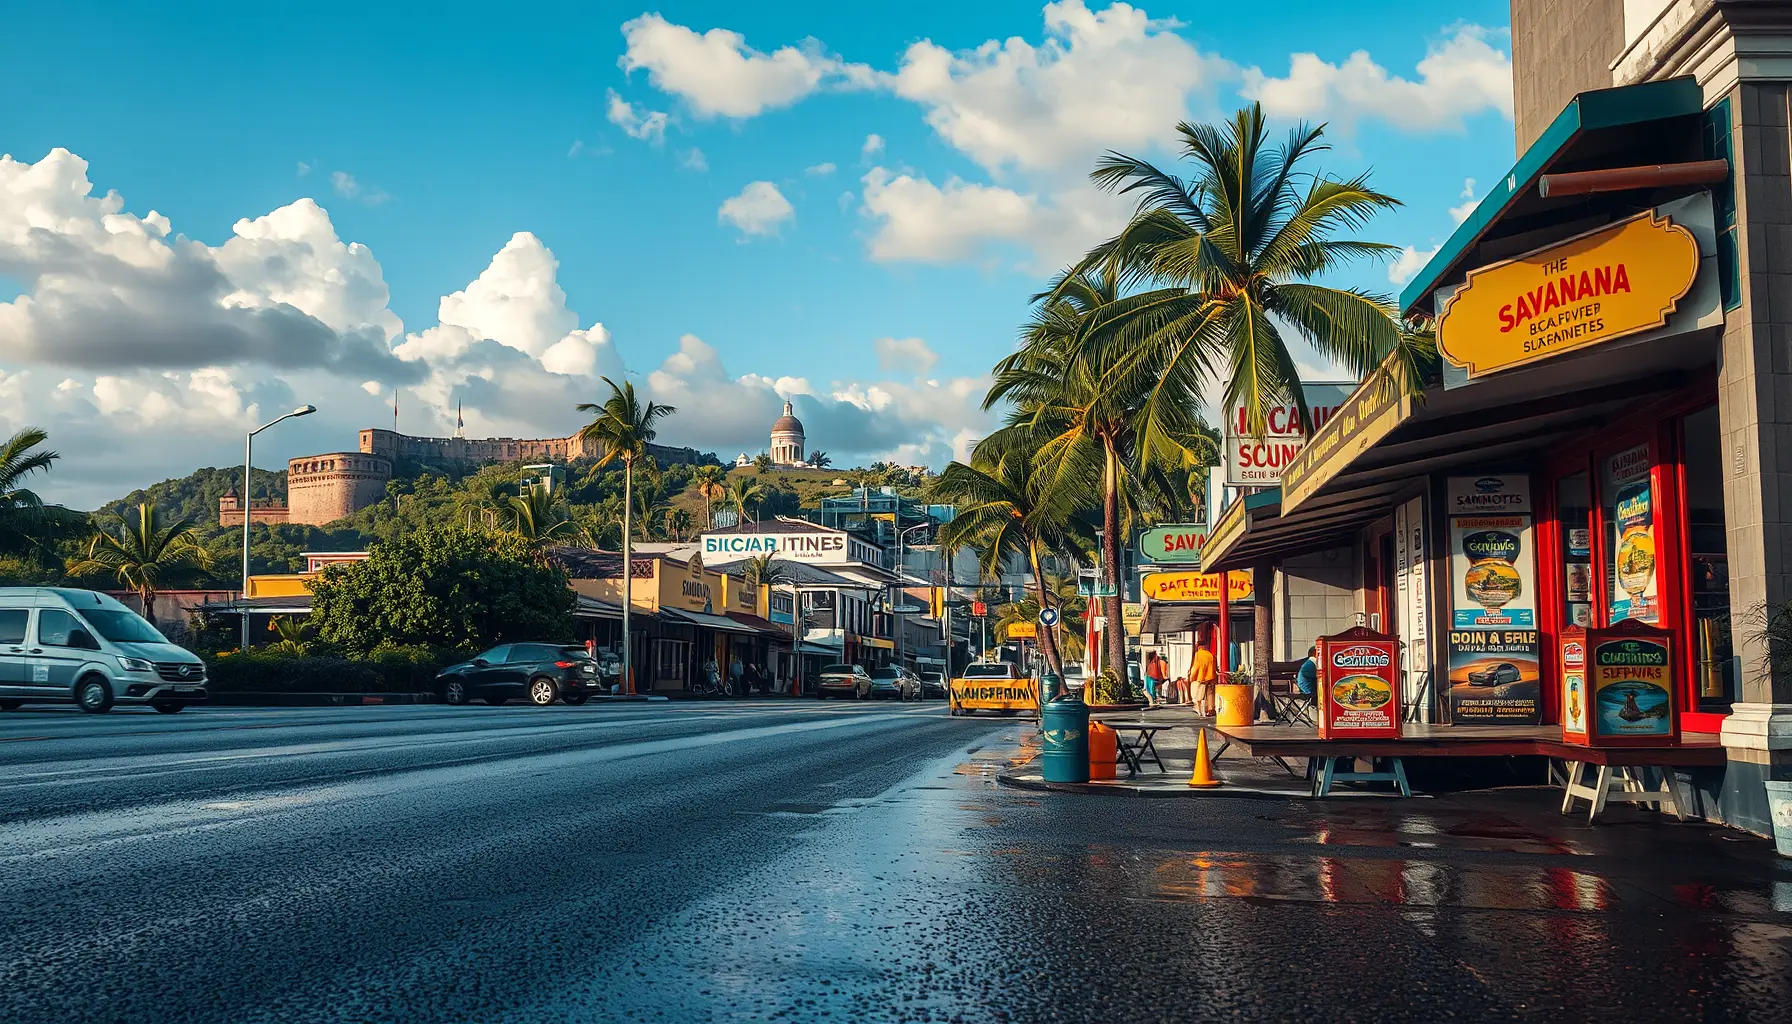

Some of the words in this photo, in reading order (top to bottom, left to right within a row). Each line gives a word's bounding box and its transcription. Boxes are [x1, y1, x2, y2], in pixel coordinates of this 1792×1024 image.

[1542, 257, 1568, 276] THE
[1498, 263, 1631, 333] SAVANANA
[1239, 443, 1303, 468] SCUN
